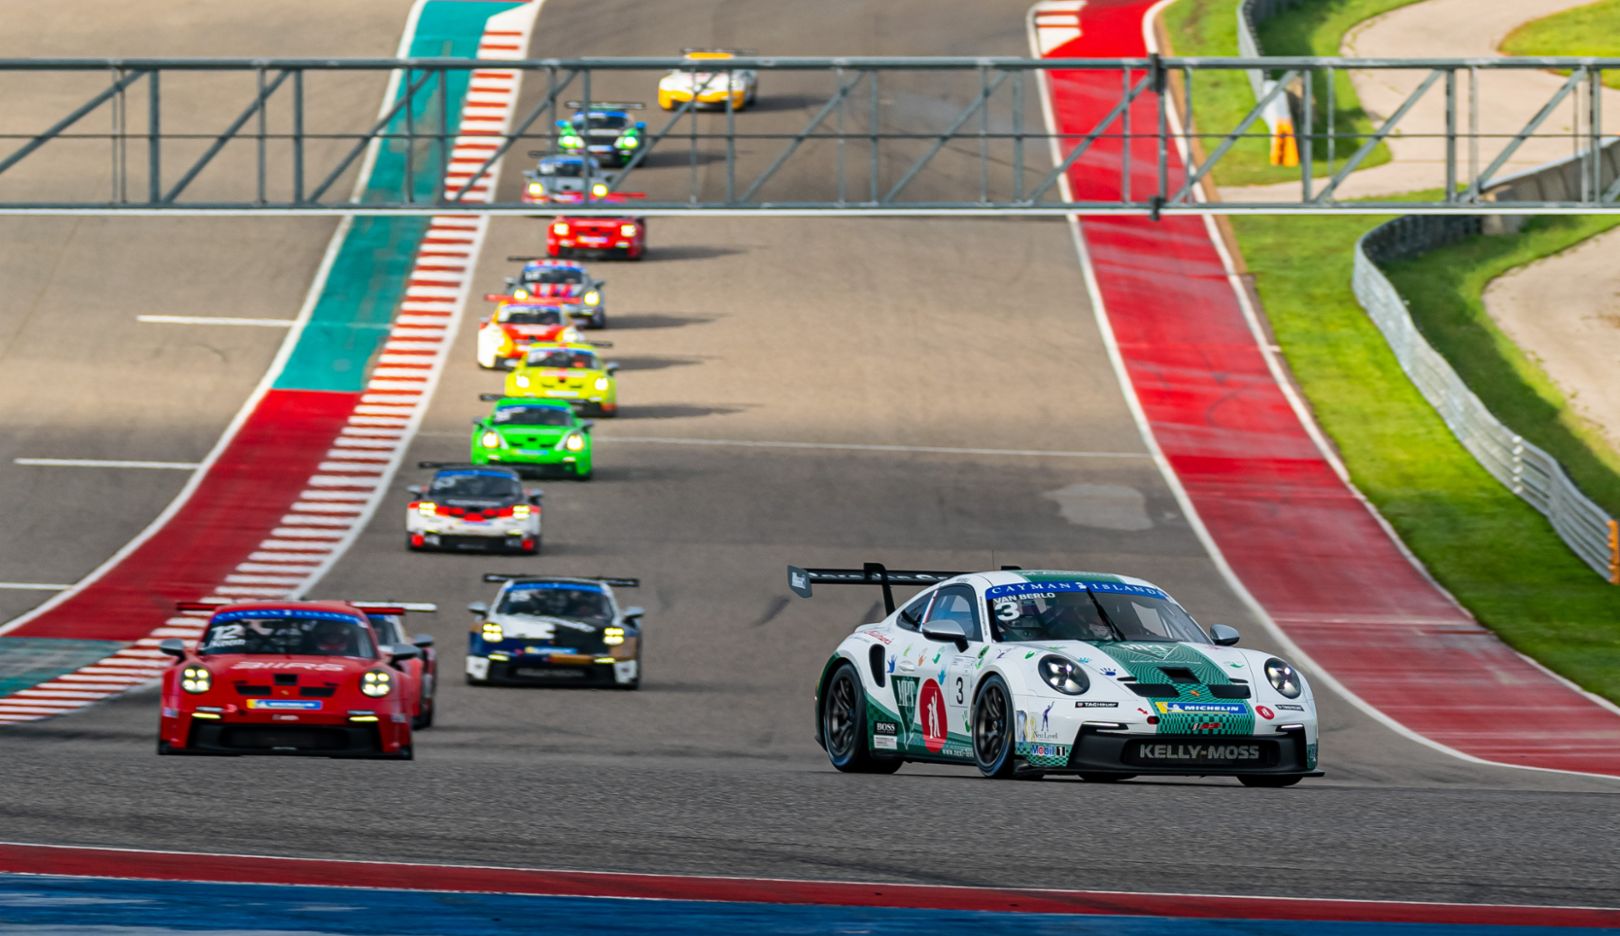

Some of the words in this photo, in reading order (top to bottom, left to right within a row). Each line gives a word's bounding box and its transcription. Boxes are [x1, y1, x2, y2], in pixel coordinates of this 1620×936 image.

[991, 582, 1071, 594] CAYMAN
[993, 594, 1017, 604] VAN
[1019, 592, 1056, 600] BERLO
[994, 601, 1020, 621] 3
[211, 624, 243, 641] 12
[956, 676, 964, 704] 3
[876, 722, 896, 731] BOSS
[1031, 744, 1055, 757] Mobil
[1139, 743, 1260, 760] KELLY-MOSS
